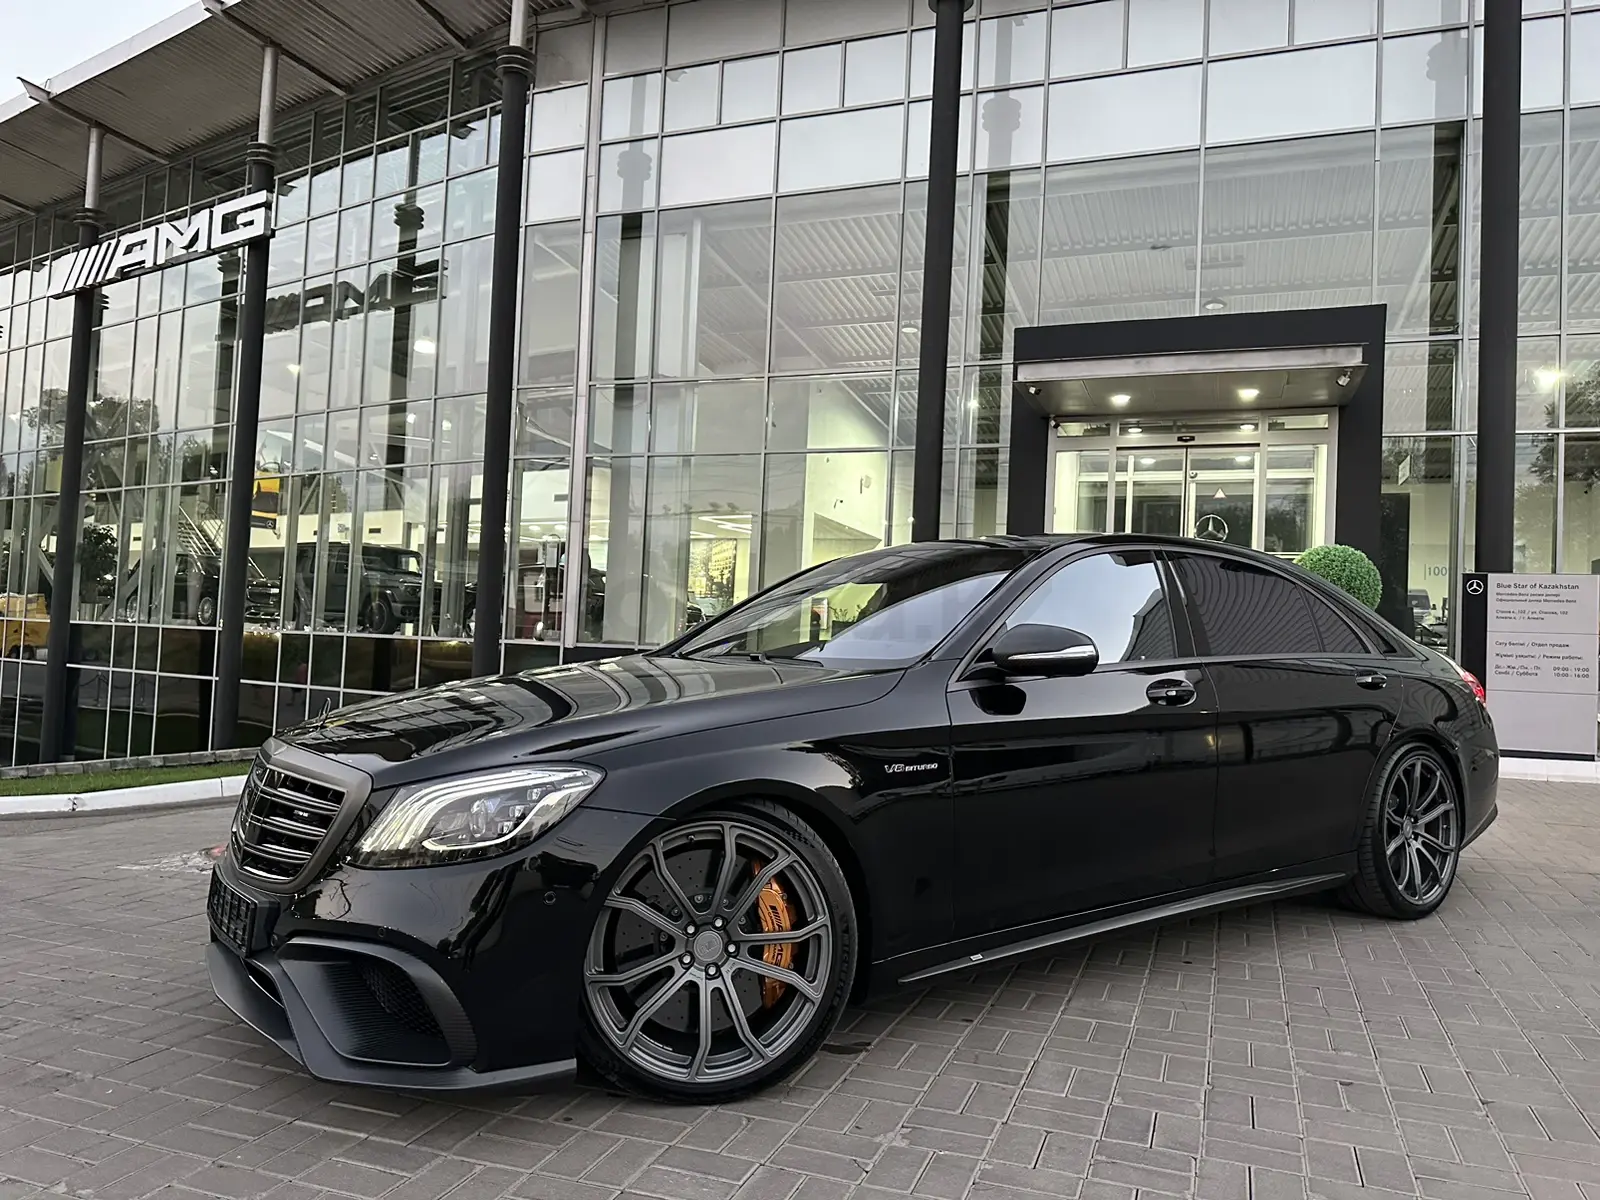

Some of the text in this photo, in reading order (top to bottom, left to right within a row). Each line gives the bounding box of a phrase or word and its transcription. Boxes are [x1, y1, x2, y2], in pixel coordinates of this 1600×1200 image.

[107, 190, 273, 281] AMG
[1496, 582, 1512, 590] Blue
[1529, 582, 1537, 590] of
